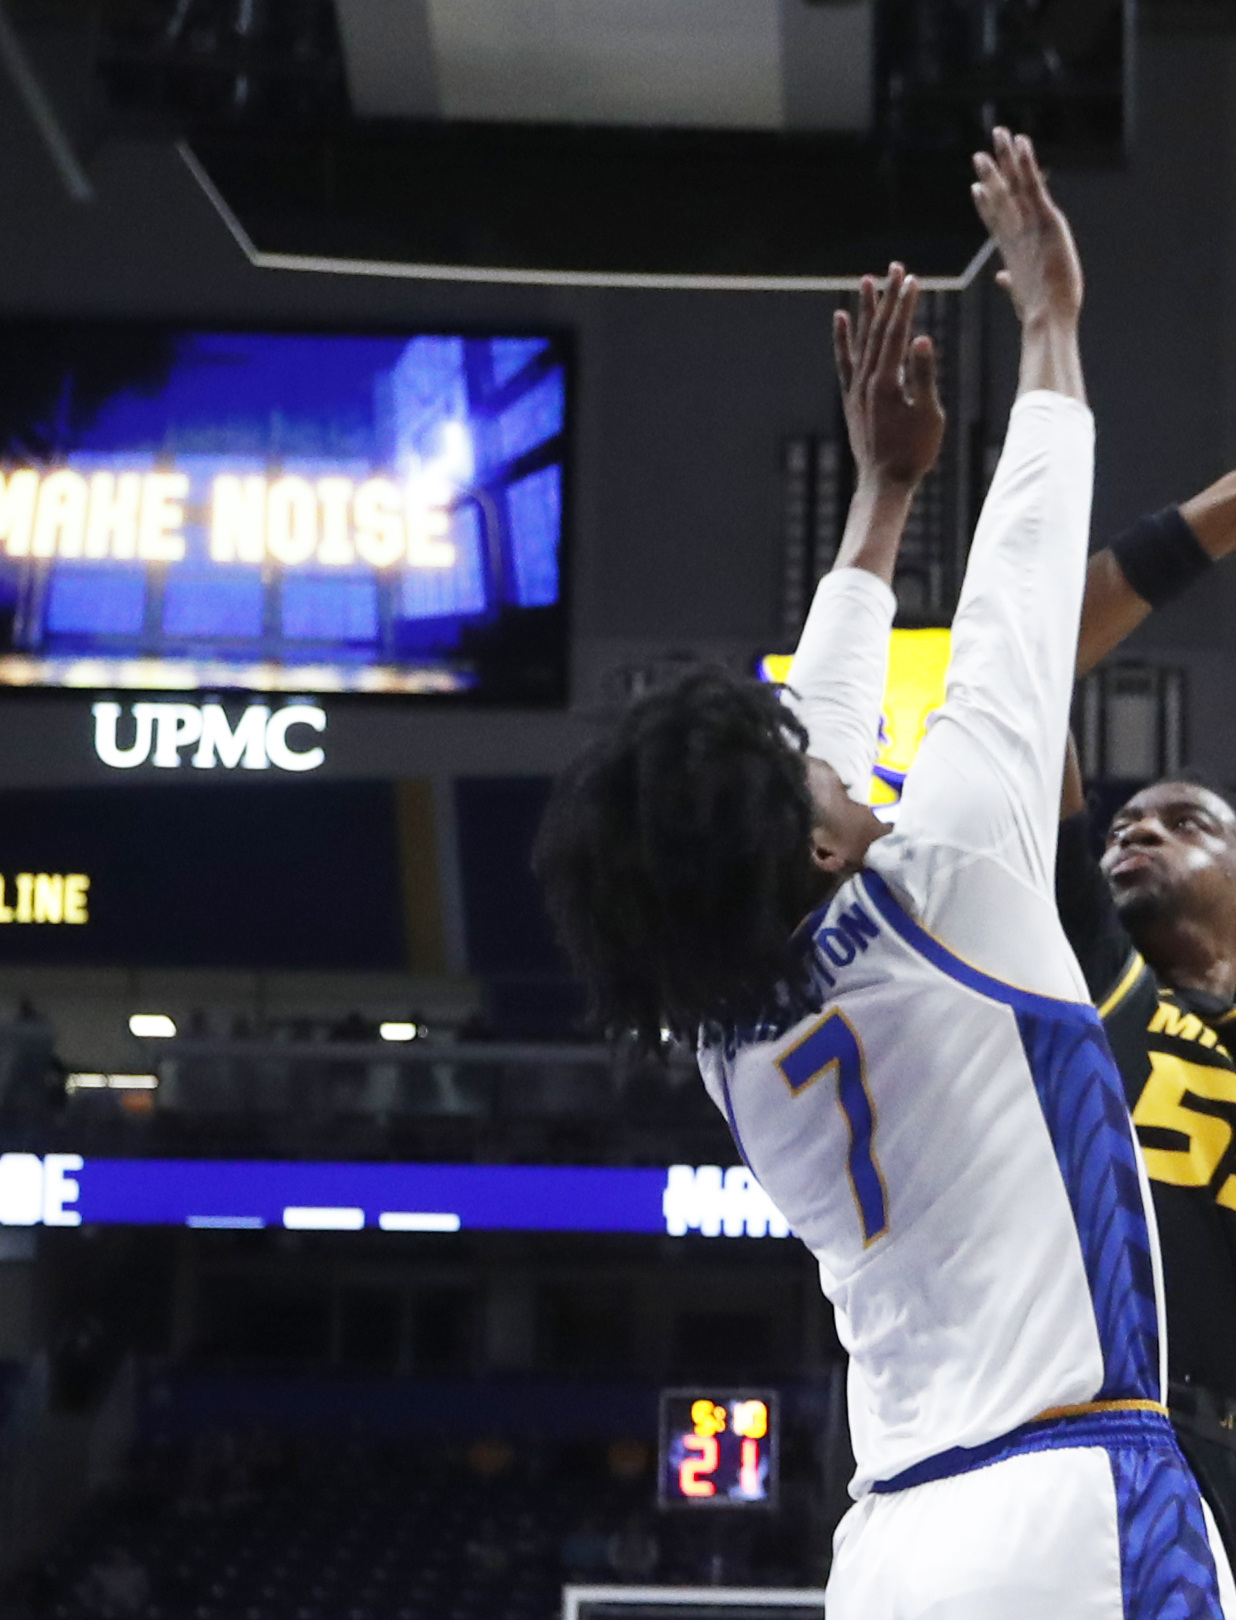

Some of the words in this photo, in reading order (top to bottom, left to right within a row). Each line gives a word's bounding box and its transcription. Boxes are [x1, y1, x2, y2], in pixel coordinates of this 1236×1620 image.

[0, 470, 190, 562] MAKE
[209, 474, 456, 568] NOISE
[92, 702, 327, 771] UPMC
[773, 1005, 891, 1250] 7
[679, 1434, 760, 1497] 21
